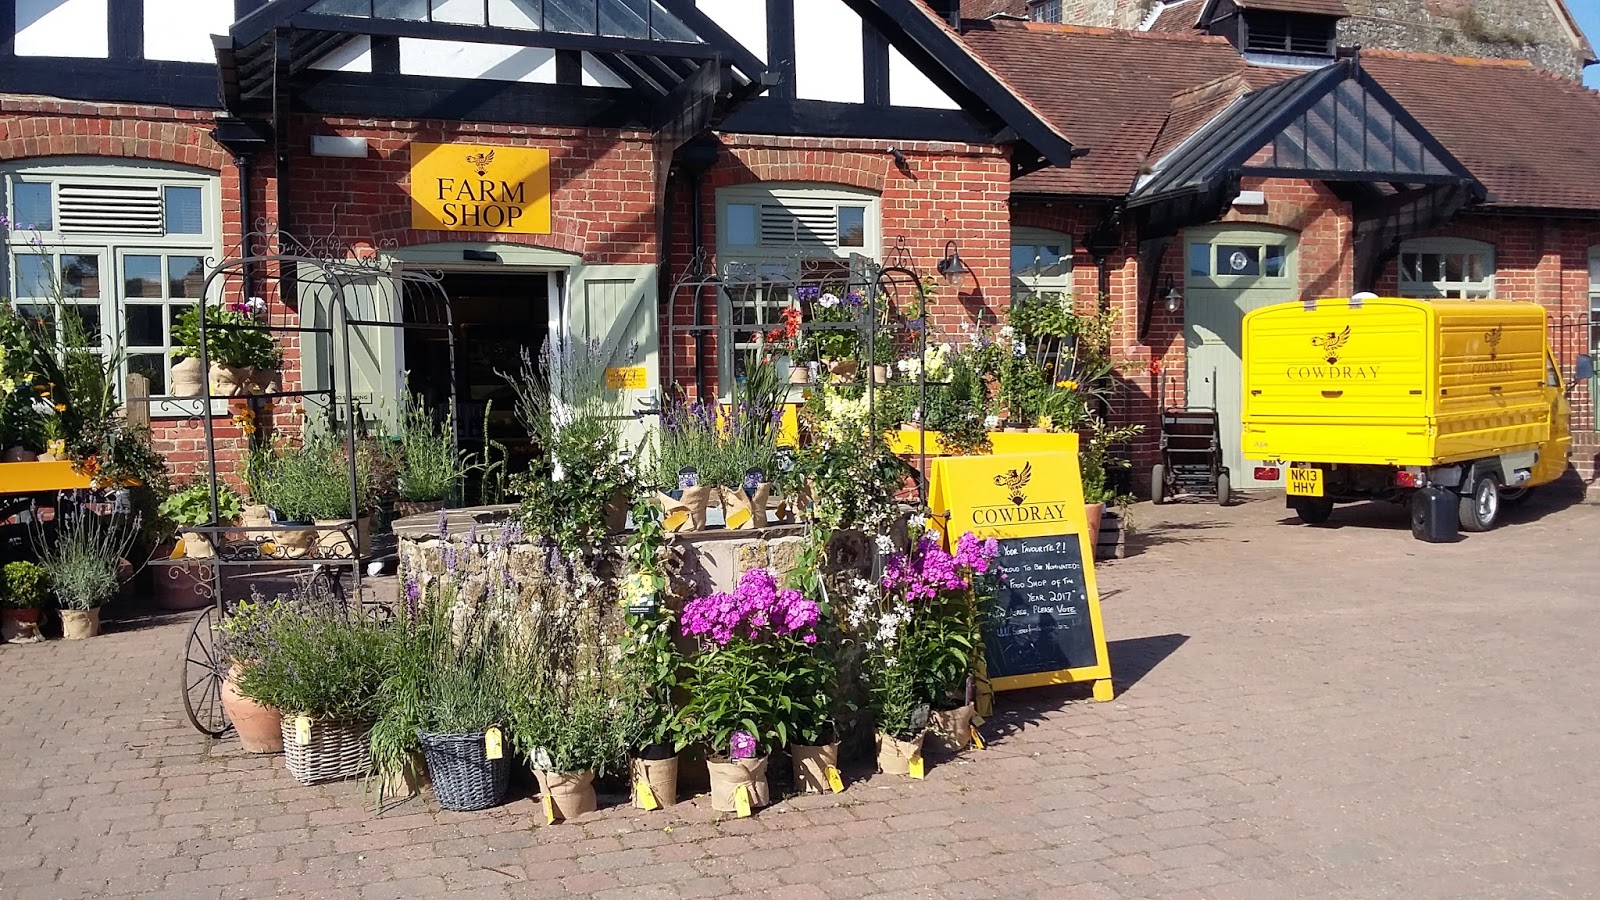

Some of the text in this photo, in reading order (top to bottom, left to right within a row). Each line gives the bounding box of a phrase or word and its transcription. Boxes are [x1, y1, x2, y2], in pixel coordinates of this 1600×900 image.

[436, 177, 526, 204] FARM
[442, 202, 523, 228] SHOP
[1286, 366, 1380, 380] COWDRAY
[1291, 469, 1317, 481] NK13
[1294, 482, 1315, 493] HHY
[972, 504, 1066, 525] COWDRAY
